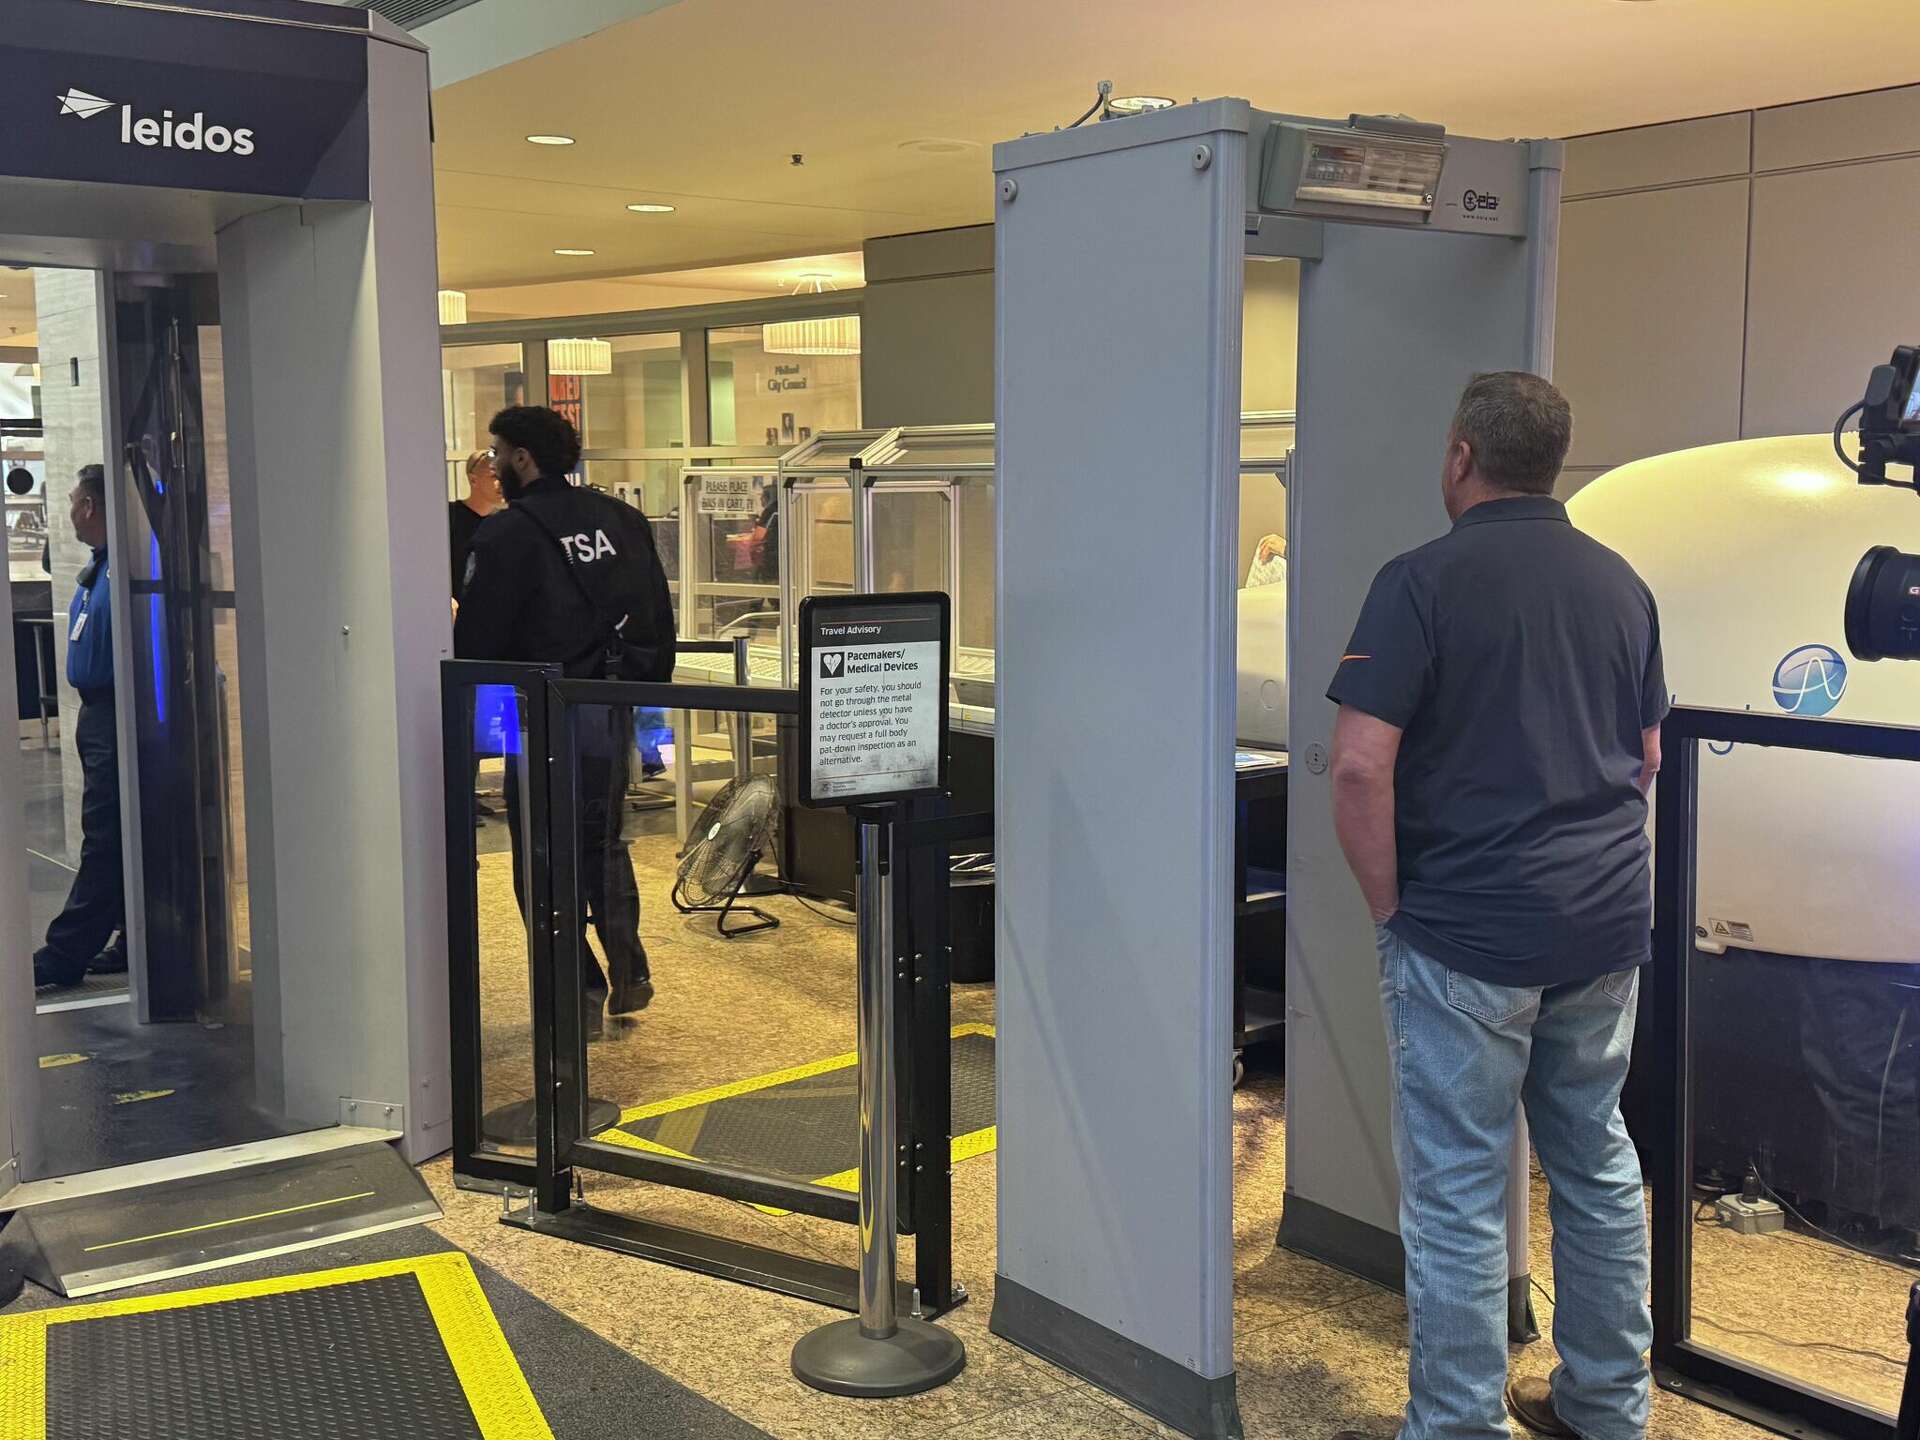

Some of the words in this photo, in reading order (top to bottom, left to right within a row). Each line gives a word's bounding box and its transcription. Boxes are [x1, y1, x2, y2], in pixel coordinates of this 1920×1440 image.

[122, 104, 255, 155] leidos
[560, 529, 616, 563] TSA
[820, 627, 845, 635] Travel
[846, 625, 882, 635] Advisory
[847, 649, 906, 661] Pacemakers/
[847, 663, 882, 674] Medical
[884, 662, 919, 672] Devices
[820, 687, 833, 695] For
[835, 687, 853, 696] your
[882, 684, 896, 693] you
[897, 681, 922, 691] should
[820, 699, 833, 707] not
[834, 699, 844, 708] go
[846, 696, 876, 706] through
[877, 695, 890, 703] the
[891, 693, 912, 702] metal
[820, 710, 851, 719] detector
[853, 708, 877, 717] unless
[879, 707, 893, 716] you
[894, 705, 913, 714] have
[819, 723, 825, 731] a
[826, 720, 857, 731] doctor's
[894, 717, 909, 726] You
[819, 735, 836, 743] may
[838, 732, 866, 742] request
[875, 729, 887, 738] full
[889, 728, 908, 738] body
[819, 745, 856, 755] pat-down
[857, 741, 896, 752] inspection
[897, 741, 906, 749] as
[906, 739, 917, 747] an
[819, 755, 863, 766] alternative.
